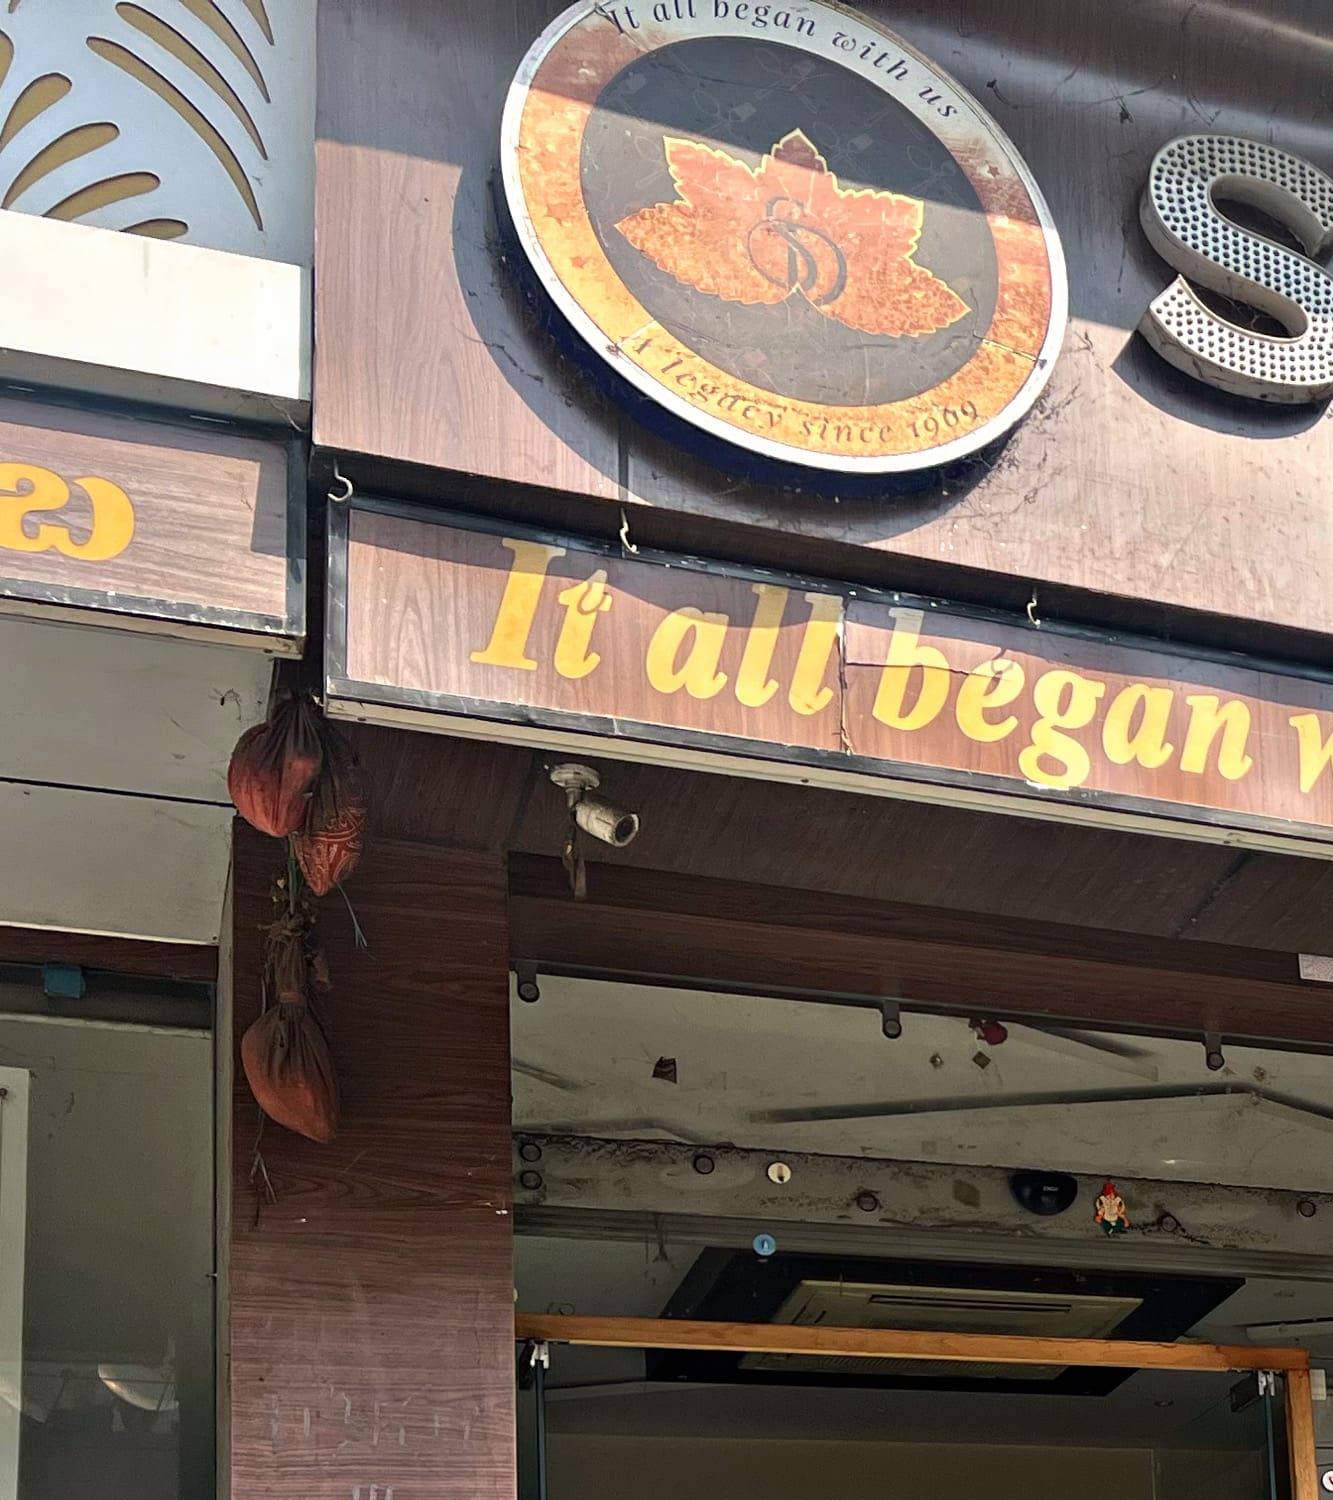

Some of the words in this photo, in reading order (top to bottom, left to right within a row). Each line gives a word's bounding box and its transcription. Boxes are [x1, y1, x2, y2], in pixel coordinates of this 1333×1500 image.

[606, 6, 640, 34] It
[653, 0, 697, 23] all
[713, 0, 816, 37] began
[831, 28, 911, 82] with
[918, 85, 959, 119] us
[660, 352, 783, 430] legacy
[799, 415, 894, 444] since
[470, 537, 613, 679] It
[645, 582, 846, 716] all
[871, 606, 1253, 790] began
